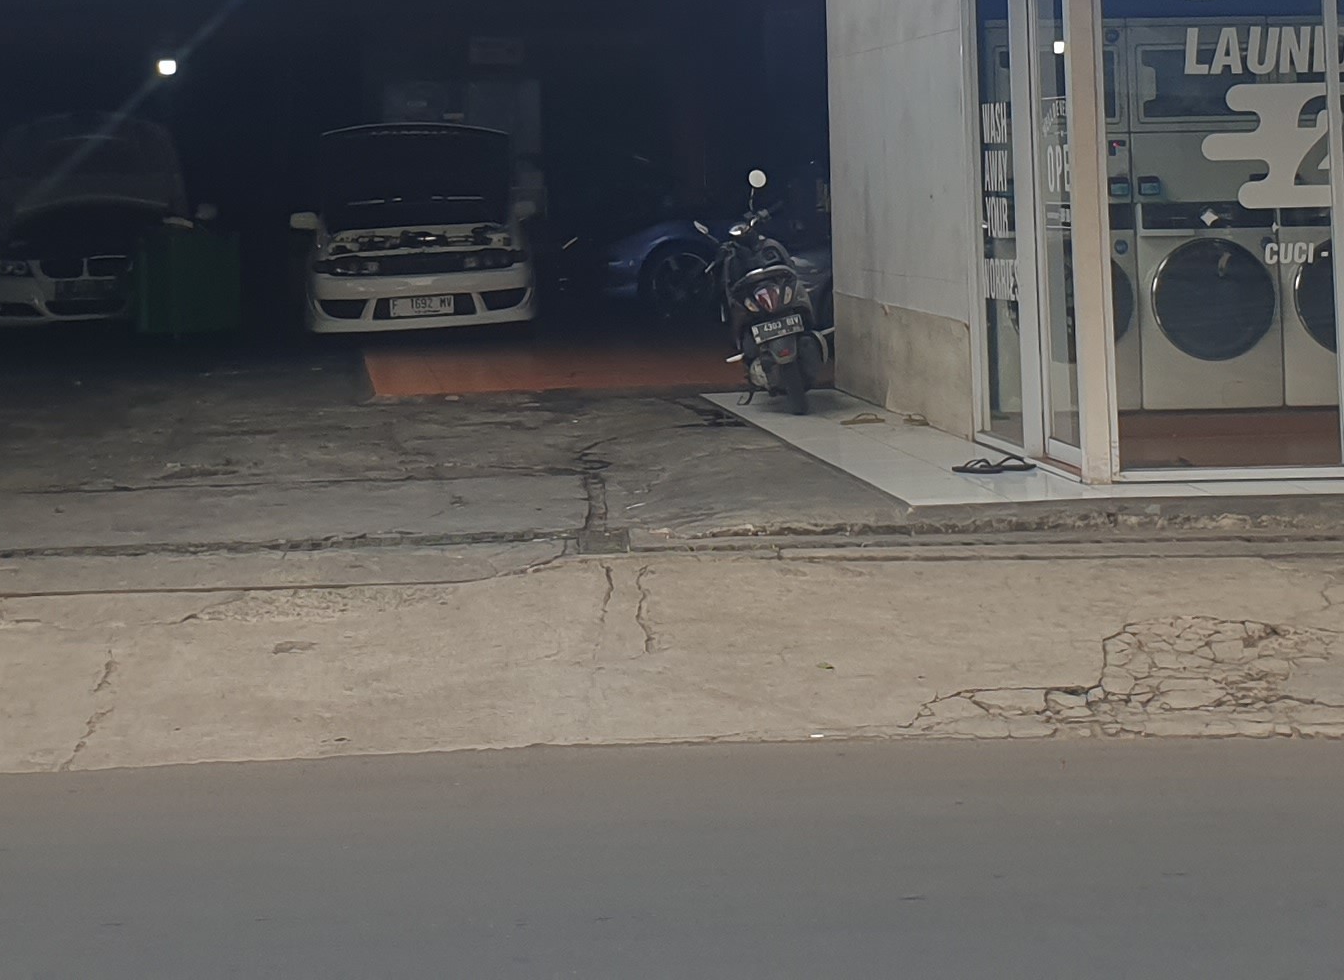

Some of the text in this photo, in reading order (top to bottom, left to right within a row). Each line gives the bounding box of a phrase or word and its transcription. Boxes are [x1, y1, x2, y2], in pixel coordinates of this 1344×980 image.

[982, 102, 1007, 144] WASH
[984, 150, 1008, 192] AWAY
[985, 196, 1009, 238] YOUR
[1264, 242, 1314, 265] CUCI
